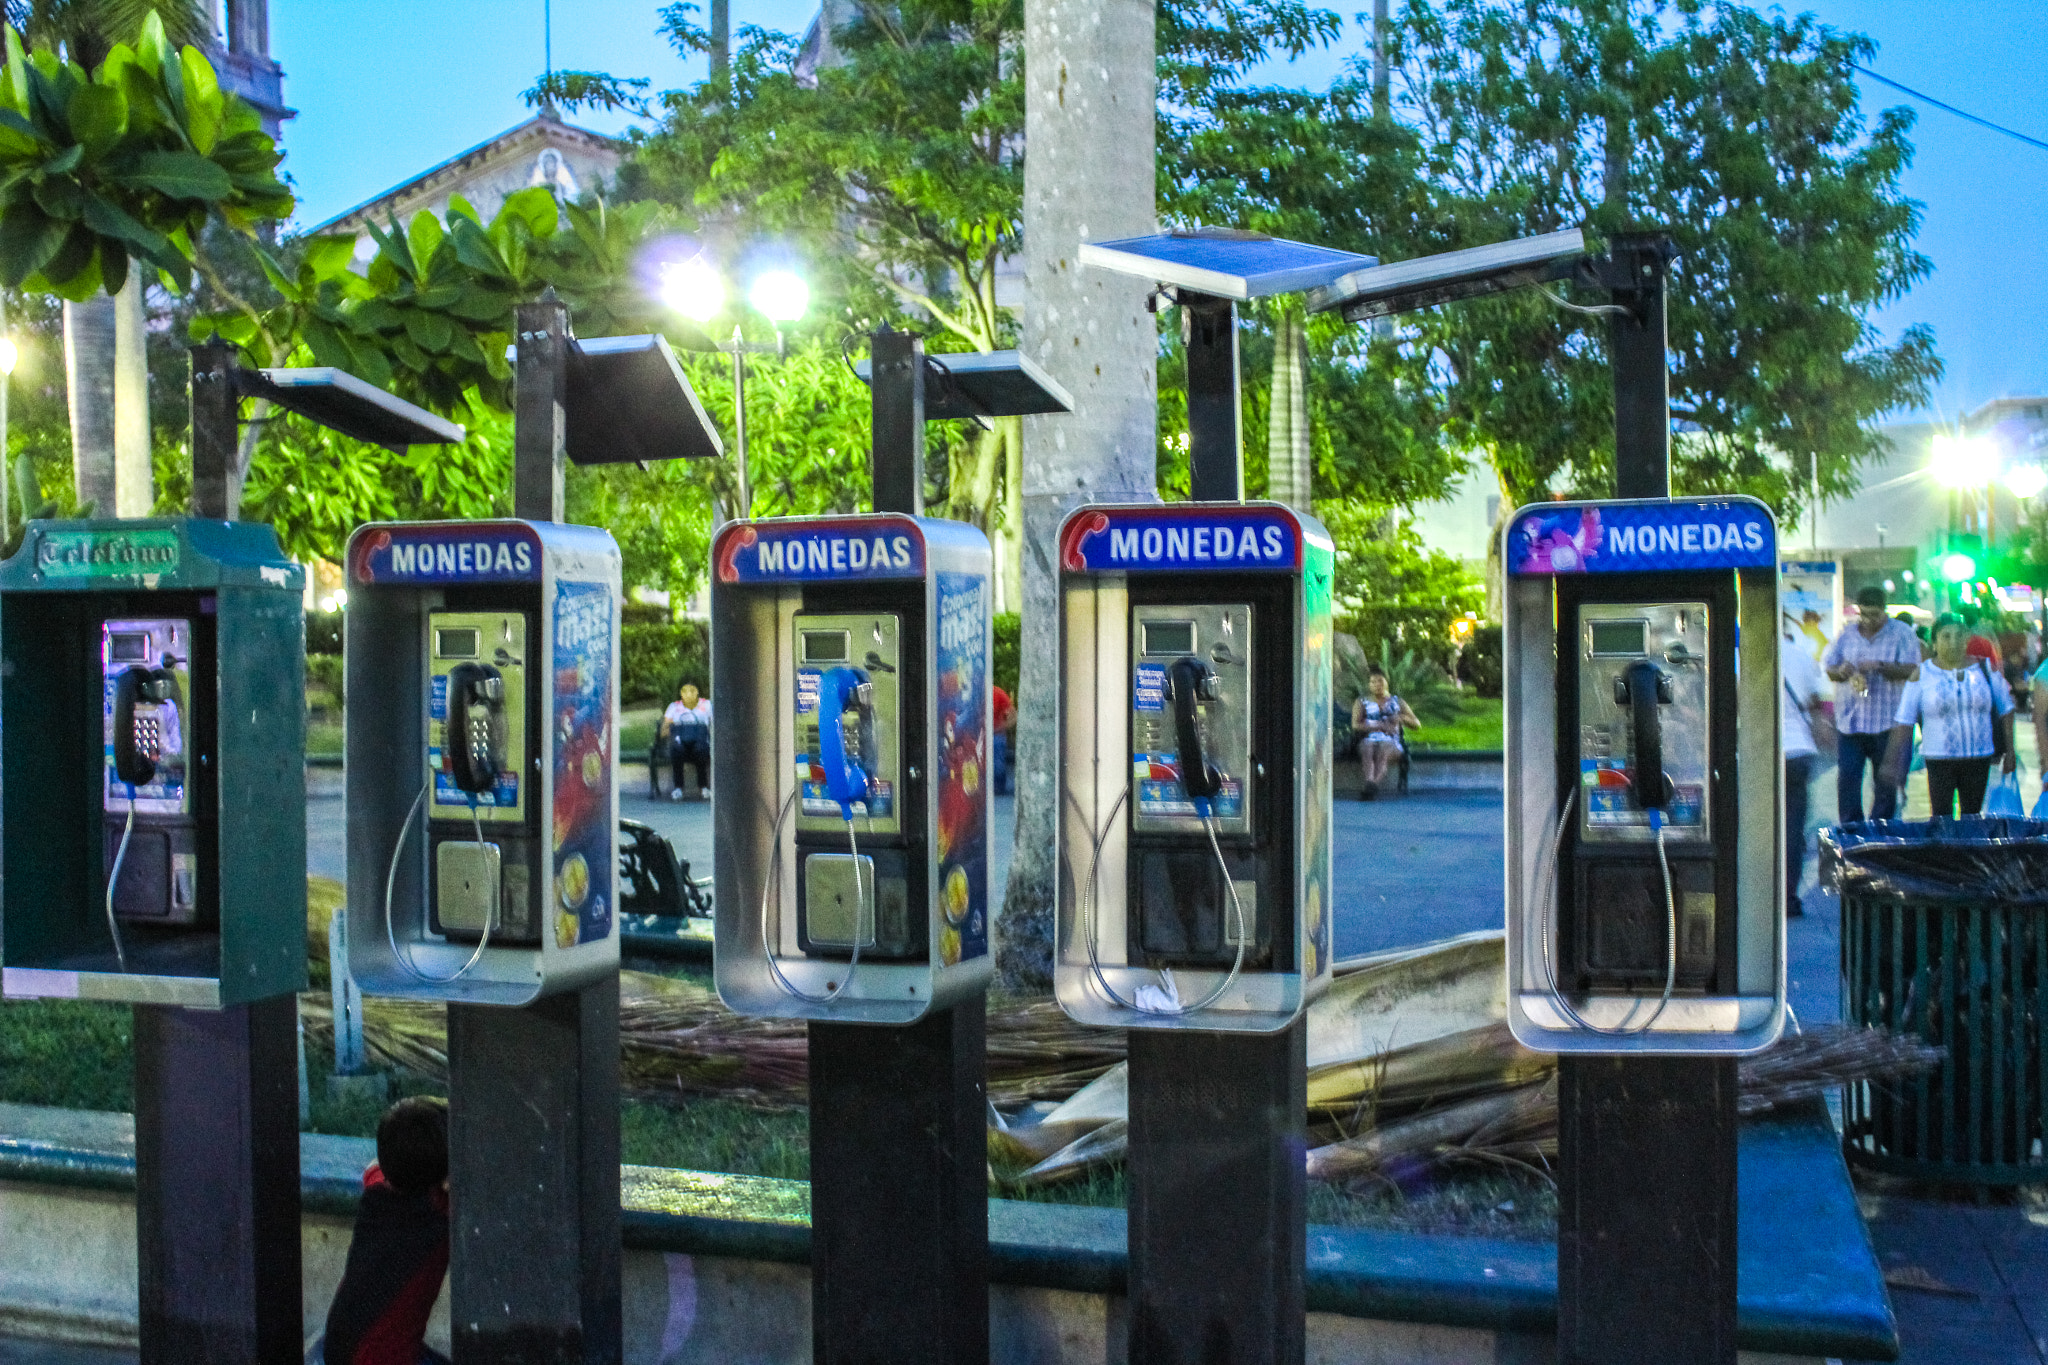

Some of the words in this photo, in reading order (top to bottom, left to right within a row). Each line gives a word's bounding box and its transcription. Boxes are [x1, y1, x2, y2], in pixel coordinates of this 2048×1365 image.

[758, 535, 911, 574] MONEDAS
[1110, 525, 1283, 562] MONEDAS
[1609, 521, 1765, 555] MONEDAS
[391, 541, 533, 575] MONEDAS
